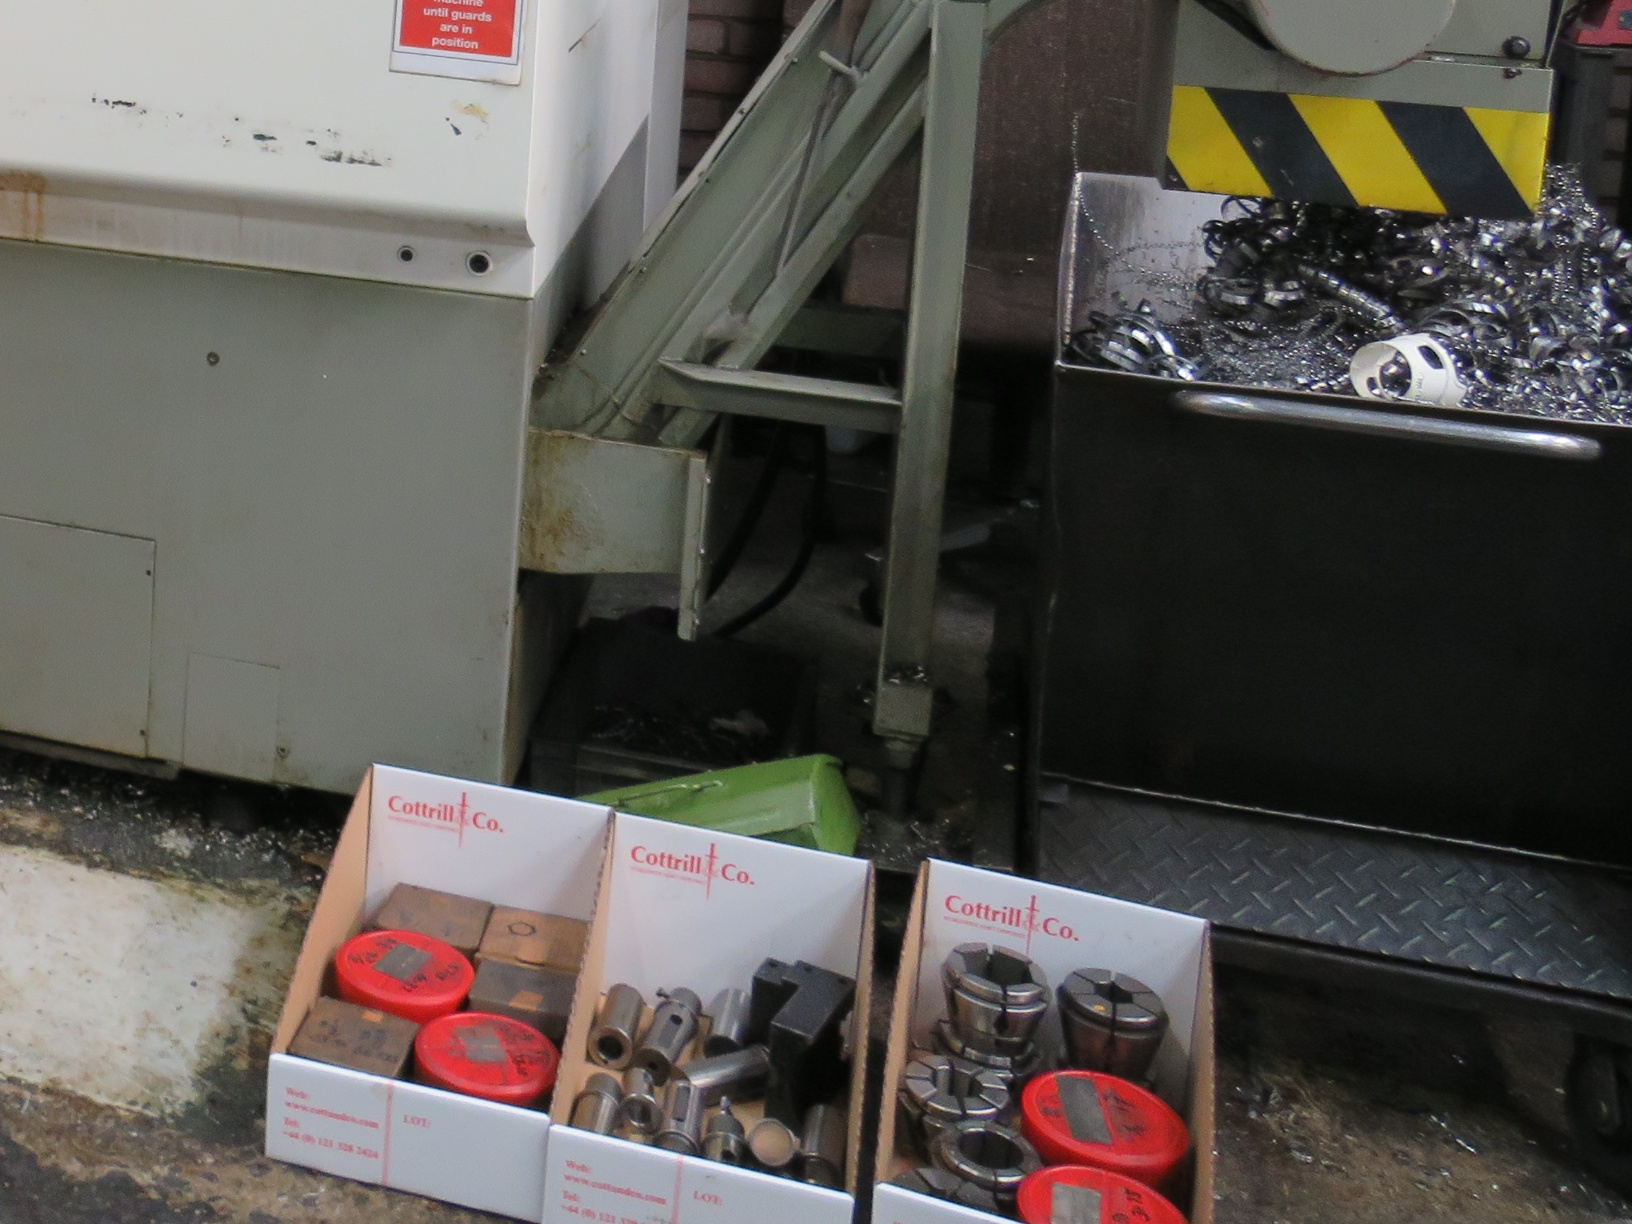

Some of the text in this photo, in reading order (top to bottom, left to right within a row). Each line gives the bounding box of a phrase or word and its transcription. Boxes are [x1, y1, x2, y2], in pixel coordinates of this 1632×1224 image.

[423, 7, 493, 23] until guards
[440, 22, 473, 35] are in
[432, 36, 478, 50] position
[388, 795, 454, 823] Cottrill
[472, 812, 504, 833] Co.
[630, 845, 702, 874] Cottrill
[721, 864, 756, 886] Co.
[944, 895, 1022, 928] Cottrill
[1042, 917, 1080, 942] Co.
